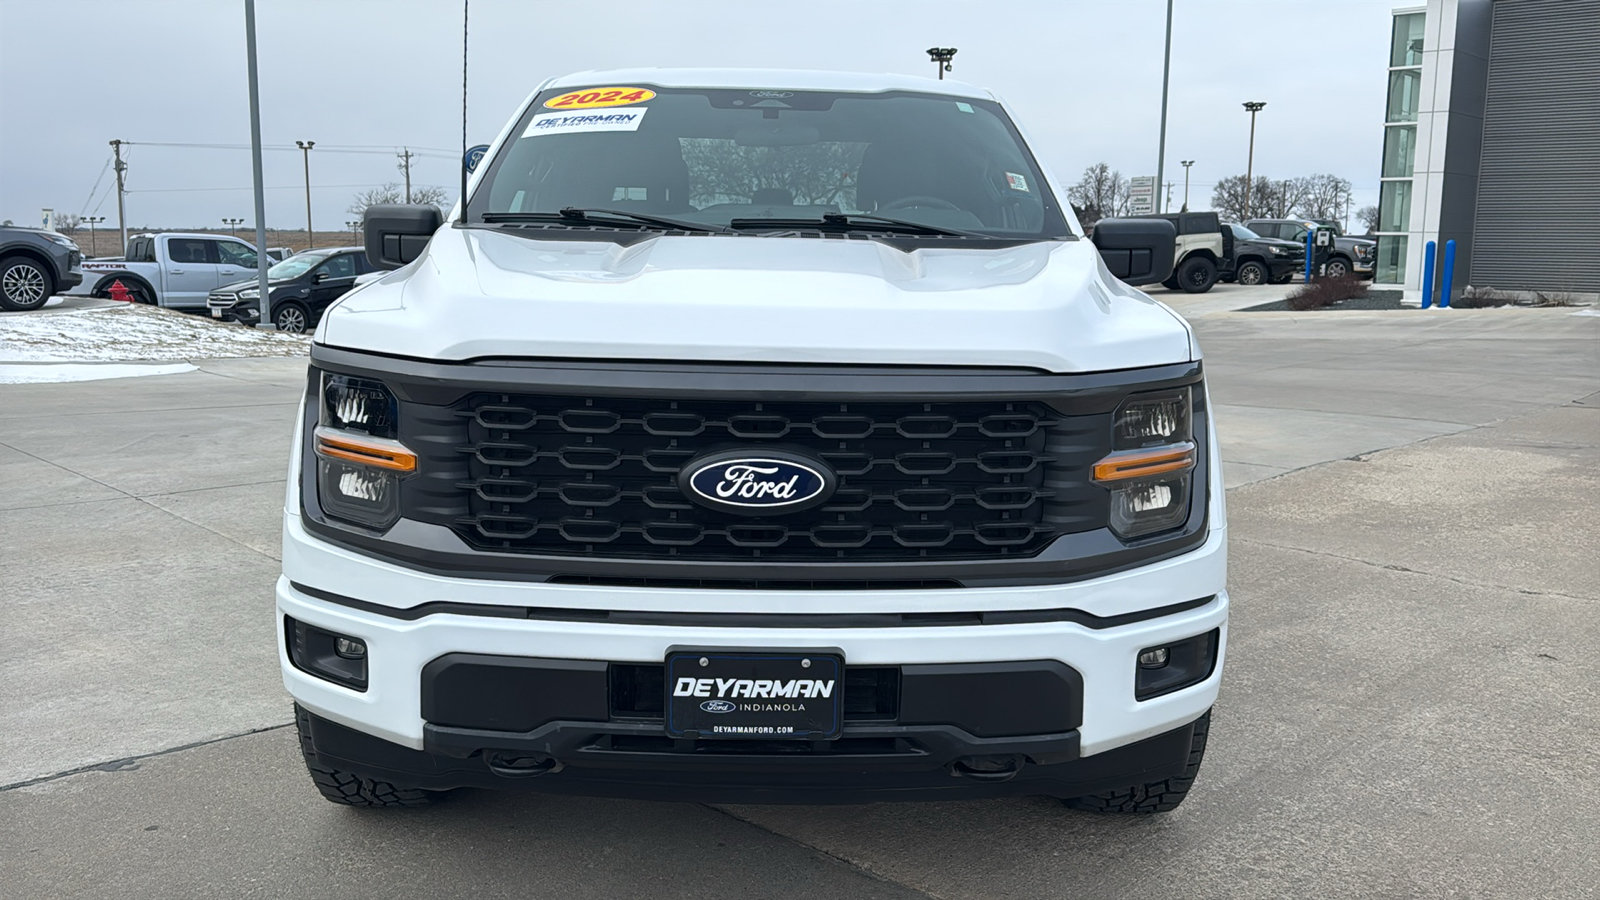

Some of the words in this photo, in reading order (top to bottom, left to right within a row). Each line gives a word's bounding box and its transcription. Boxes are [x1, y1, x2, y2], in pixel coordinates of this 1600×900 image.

[553, 90, 645, 107] 2024
[535, 114, 638, 127] DEYARMAN
[540, 121, 581, 129] CERTIFIED
[716, 465, 799, 499] Ford
[673, 677, 835, 699] DEYARMAN
[706, 701, 729, 712] Ford
[739, 703, 806, 712] INDIANOLA
[713, 725, 794, 734] DEYARMANFORD.COM
